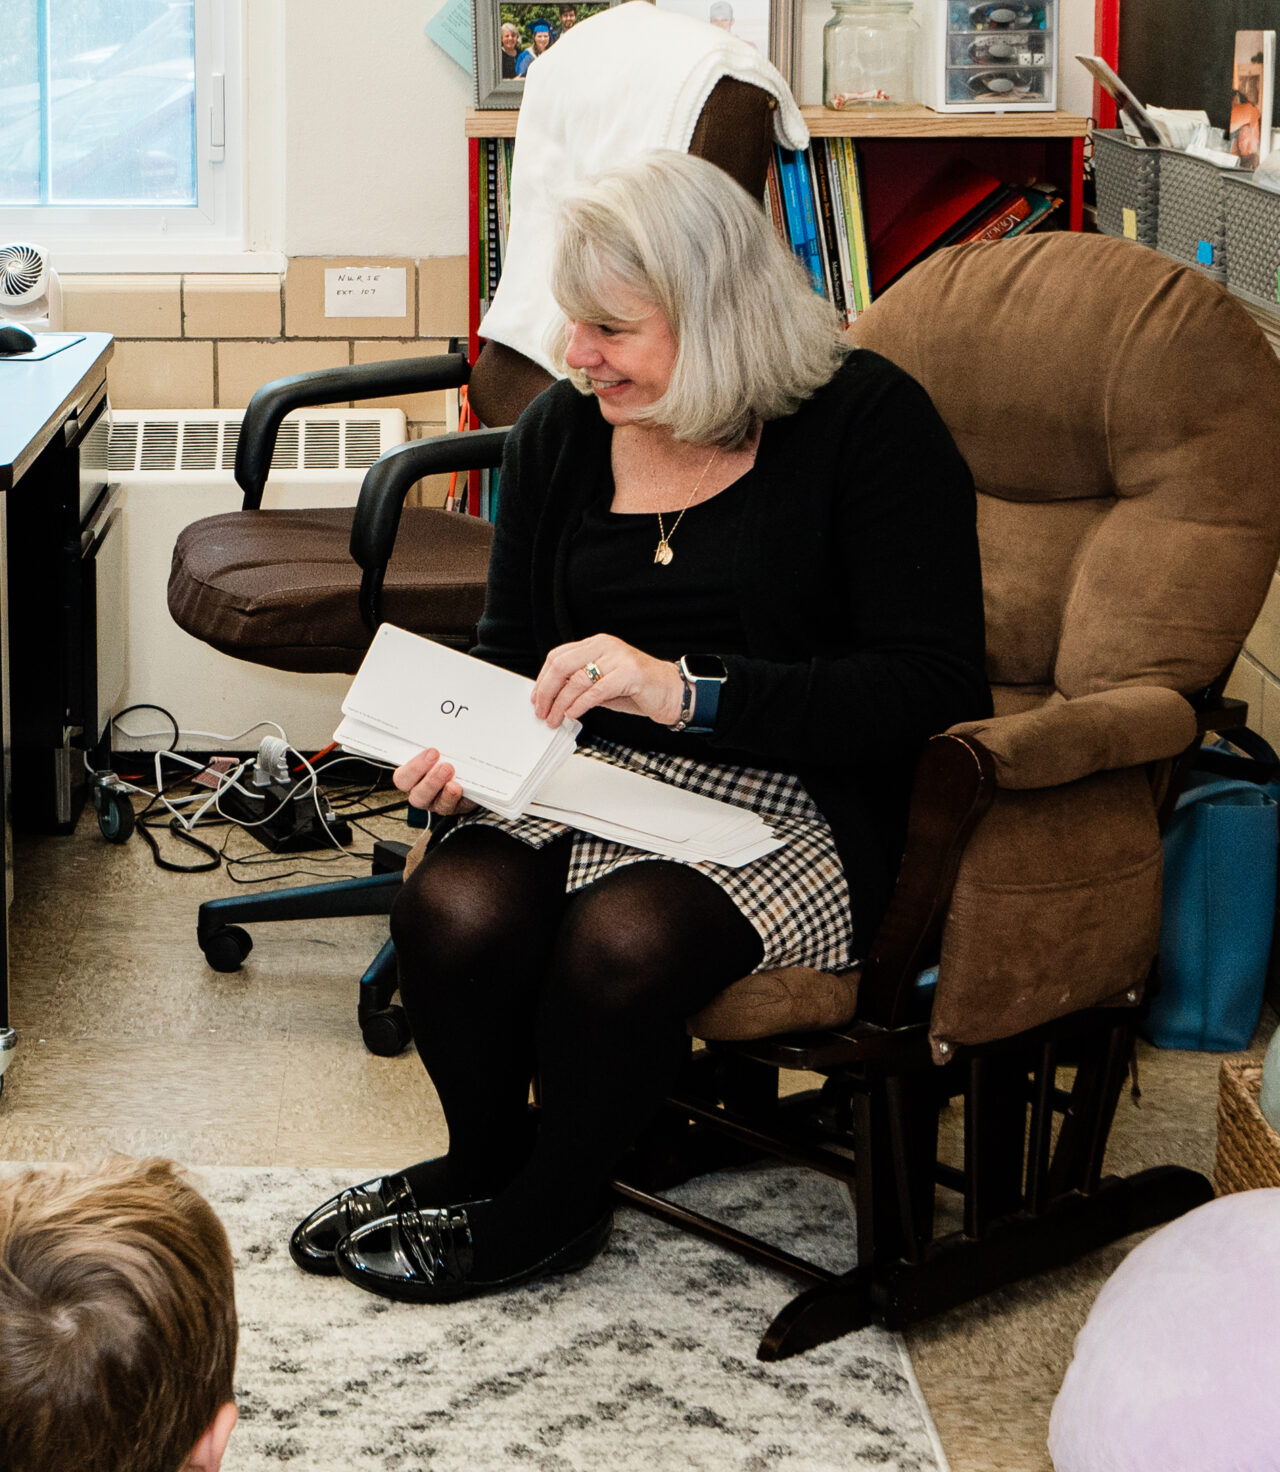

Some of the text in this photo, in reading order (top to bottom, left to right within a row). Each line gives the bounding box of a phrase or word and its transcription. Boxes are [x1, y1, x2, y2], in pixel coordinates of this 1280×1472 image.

[337, 274, 381, 283] NURSE
[360, 288, 377, 296] 107
[440, 699, 469, 718] or
